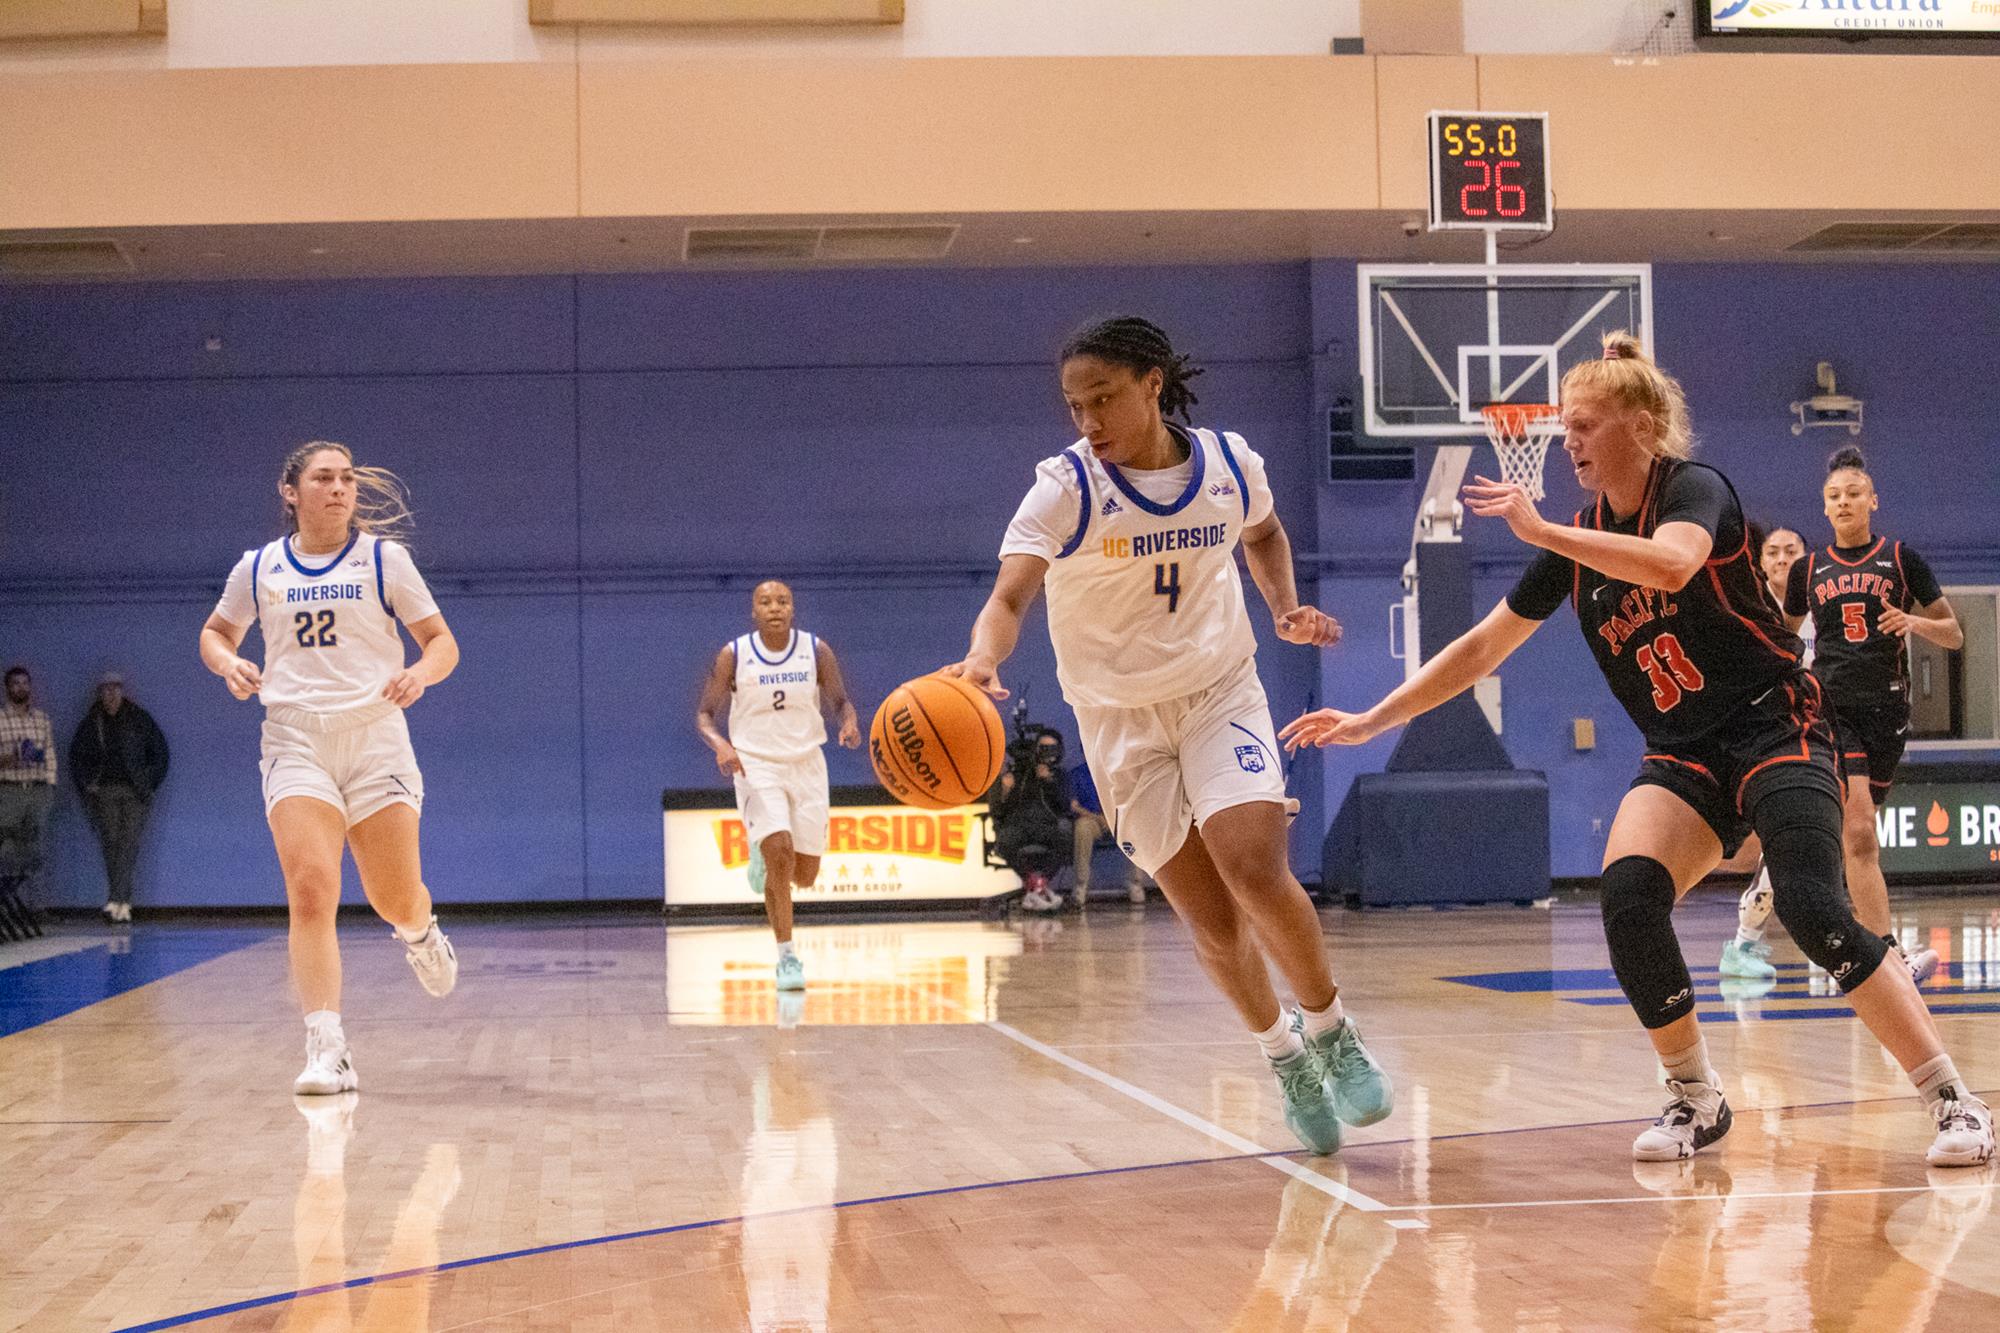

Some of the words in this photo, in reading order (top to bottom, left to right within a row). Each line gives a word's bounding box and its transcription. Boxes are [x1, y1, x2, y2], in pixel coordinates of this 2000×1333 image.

[1834, 18, 1888, 28] CREDIT
[1898, 18, 1944, 28] UNION
[1444, 123, 1517, 156] 55.0
[1461, 160, 1526, 217] 26
[1103, 537, 1129, 558] UC
[1133, 522, 1227, 557] RIVERSIDE
[287, 584, 363, 602] RIVERSIDE
[1154, 562, 1181, 613] 4
[1815, 573, 1894, 606] PACIFIC
[295, 609, 337, 647] 22
[1599, 586, 1678, 657] PACIFC
[1841, 602, 1869, 643] 5
[759, 671, 809, 685] RIVERSIDE
[1636, 632, 1705, 713] 33
[772, 690, 785, 711] 2
[891, 704, 942, 790] Wilson
[720, 814, 965, 863] RRSIDE
[1960, 804, 2000, 845] BR
[833, 884, 858, 893] AUTO
[865, 883, 902, 892] GROUP
